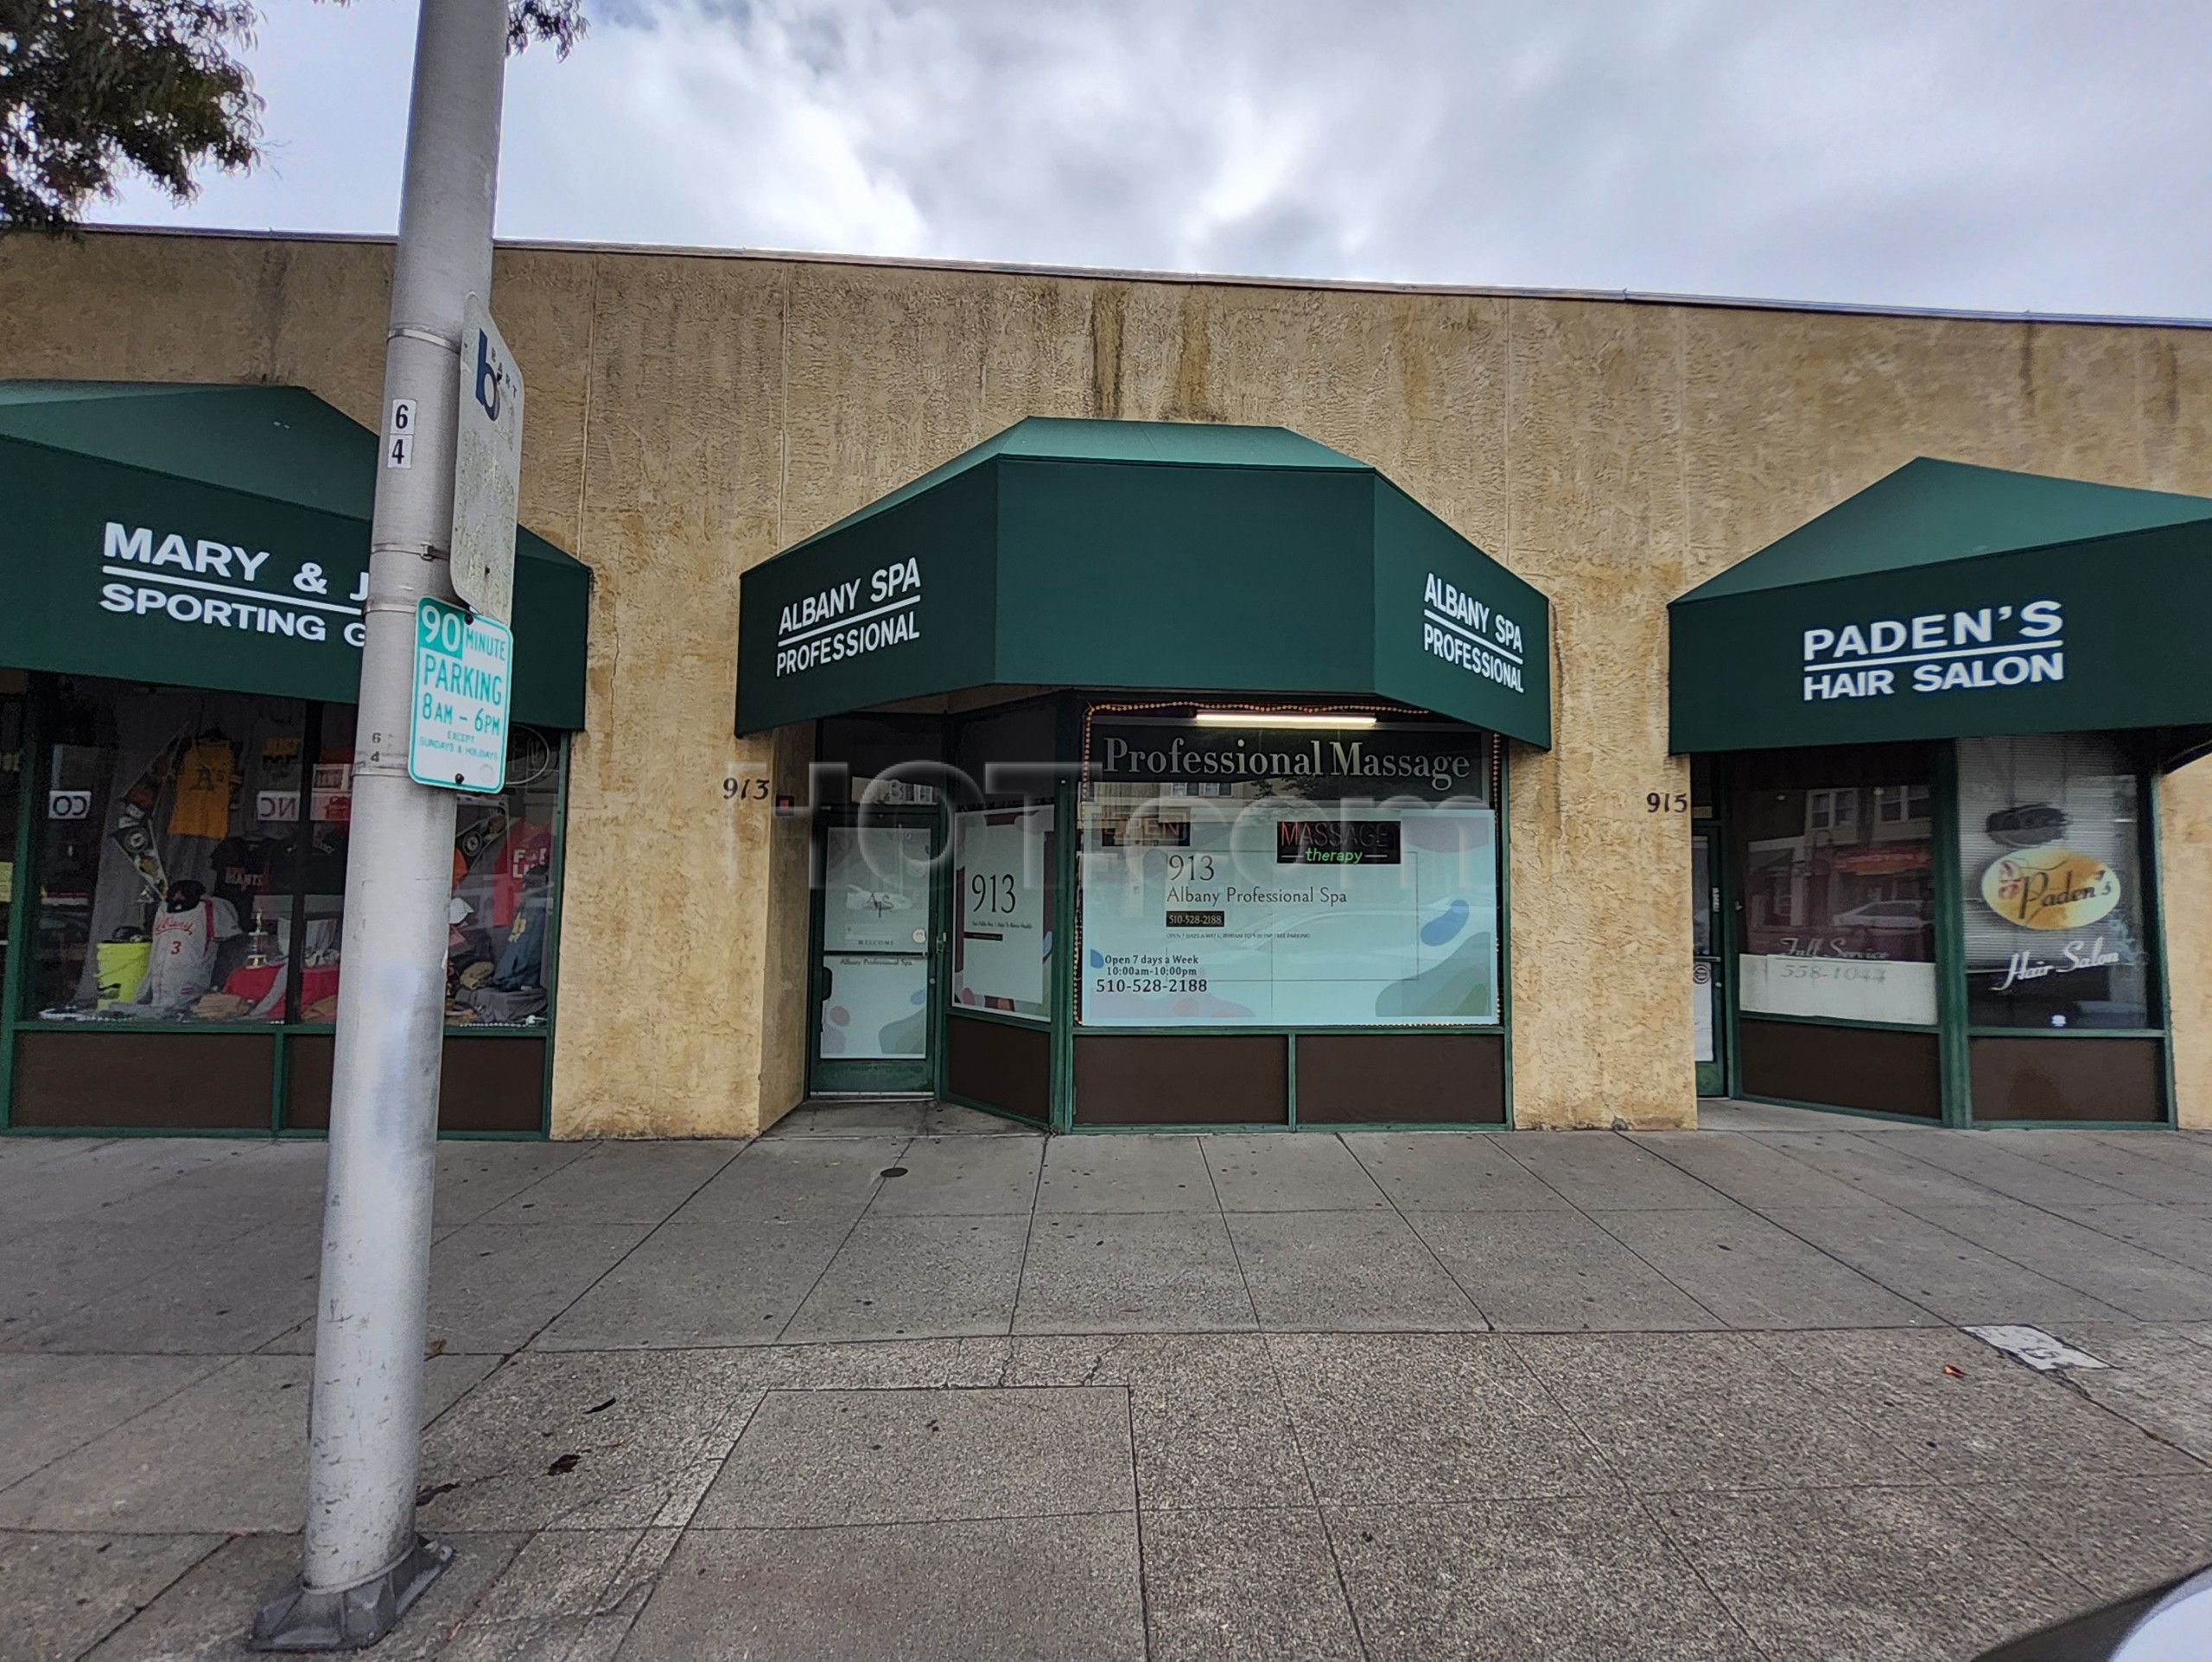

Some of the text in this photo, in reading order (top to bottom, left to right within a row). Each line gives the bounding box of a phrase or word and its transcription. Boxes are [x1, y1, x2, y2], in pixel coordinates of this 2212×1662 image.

[104, 521, 270, 583] MARY
[293, 562, 327, 595] &
[778, 557, 922, 636] ALBANY SPA
[99, 583, 327, 641] SPORTING
[1424, 572, 1523, 653] ALBANY SPA
[421, 605, 506, 661] 90 MINUTE
[776, 610, 921, 678] PROFESSIONAL
[1803, 600, 2064, 661] PADEN'S
[1423, 622, 1525, 694] PROFESSIONAL
[423, 653, 503, 706] PARKING
[1803, 652, 2065, 702] HAIR SALON
[419, 736, 454, 752] SUNDAYS
[465, 747, 499, 761] HOLIDAYS
[447, 730, 475, 744] EXCEPT
[1103, 737, 1471, 791] Professional Massage
[722, 777, 770, 800] 913
[1646, 792, 1688, 813] 915
[1281, 821, 1389, 847] MASSAGE
[1168, 854, 1215, 882] 913
[1305, 847, 1363, 864] therapy
[971, 874, 1016, 914] 913
[1166, 885, 1348, 907] Albany Professional Spa
[2018, 868, 2112, 920] Paden's
[1168, 914, 1222, 926] 510-528-2188
[171, 940, 181, 954] 3
[1104, 954, 1131, 966] Open
[1132, 954, 1139, 965] 7
[1141, 954, 1163, 966] days
[1172, 954, 1199, 965] Week
[1779, 937, 1823, 958] Full
[840, 957, 913, 967] Albany Professional Spa
[1107, 965, 1198, 977] 10:00am-10:00pm
[1991, 935, 2120, 991] Hair Salon
[1096, 978, 1208, 993] 510-528-2188
